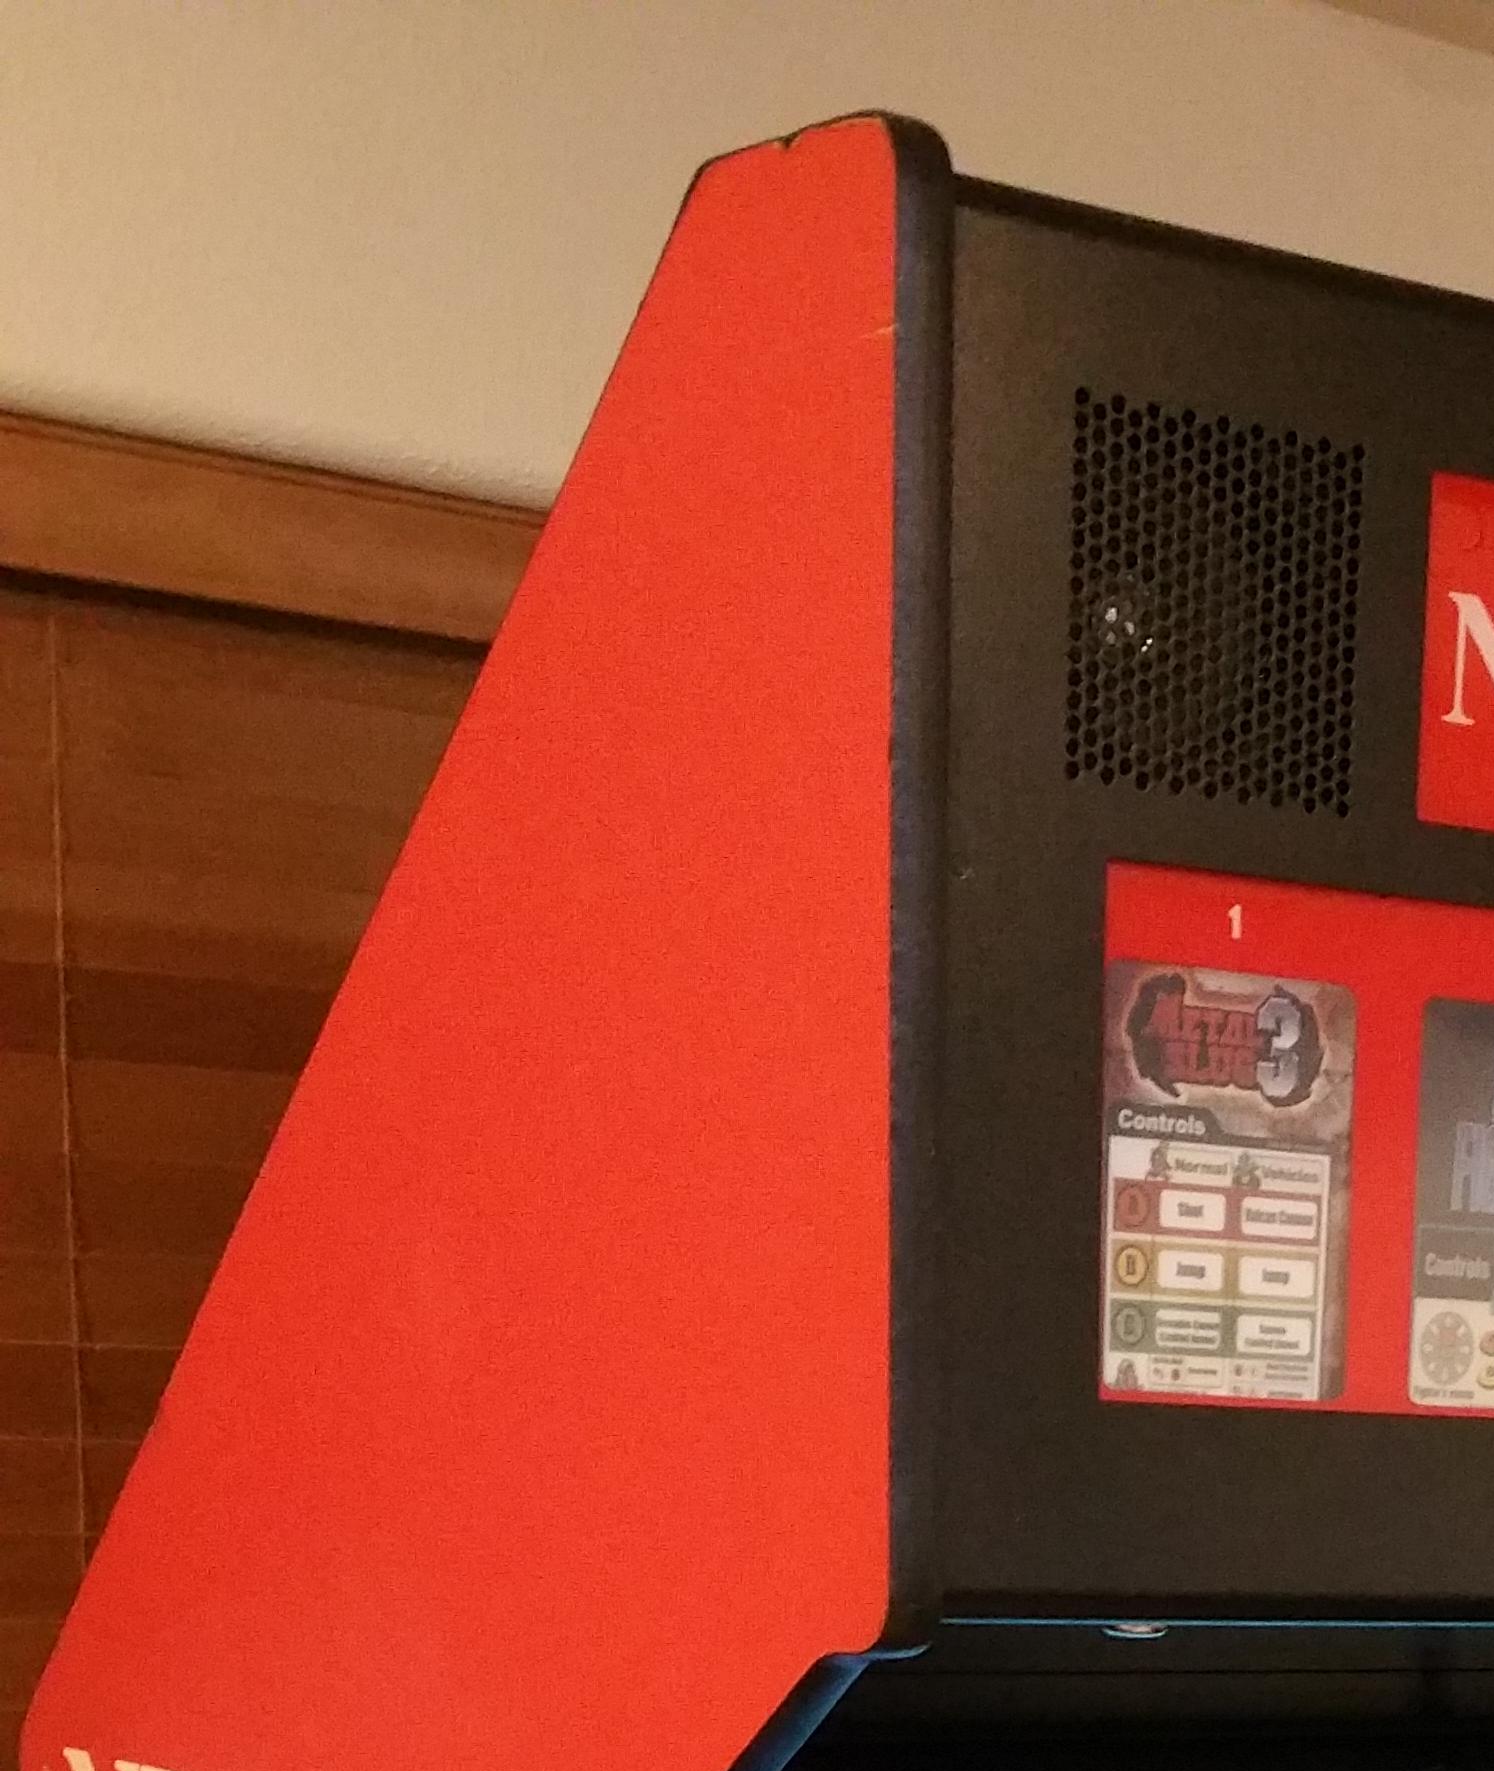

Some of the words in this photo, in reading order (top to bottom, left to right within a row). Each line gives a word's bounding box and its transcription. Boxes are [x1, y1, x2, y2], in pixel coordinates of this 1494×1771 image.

[1228, 903, 1243, 939] 1
[1257, 996, 1303, 1099] 3
[1117, 1108, 1207, 1136] Controls
